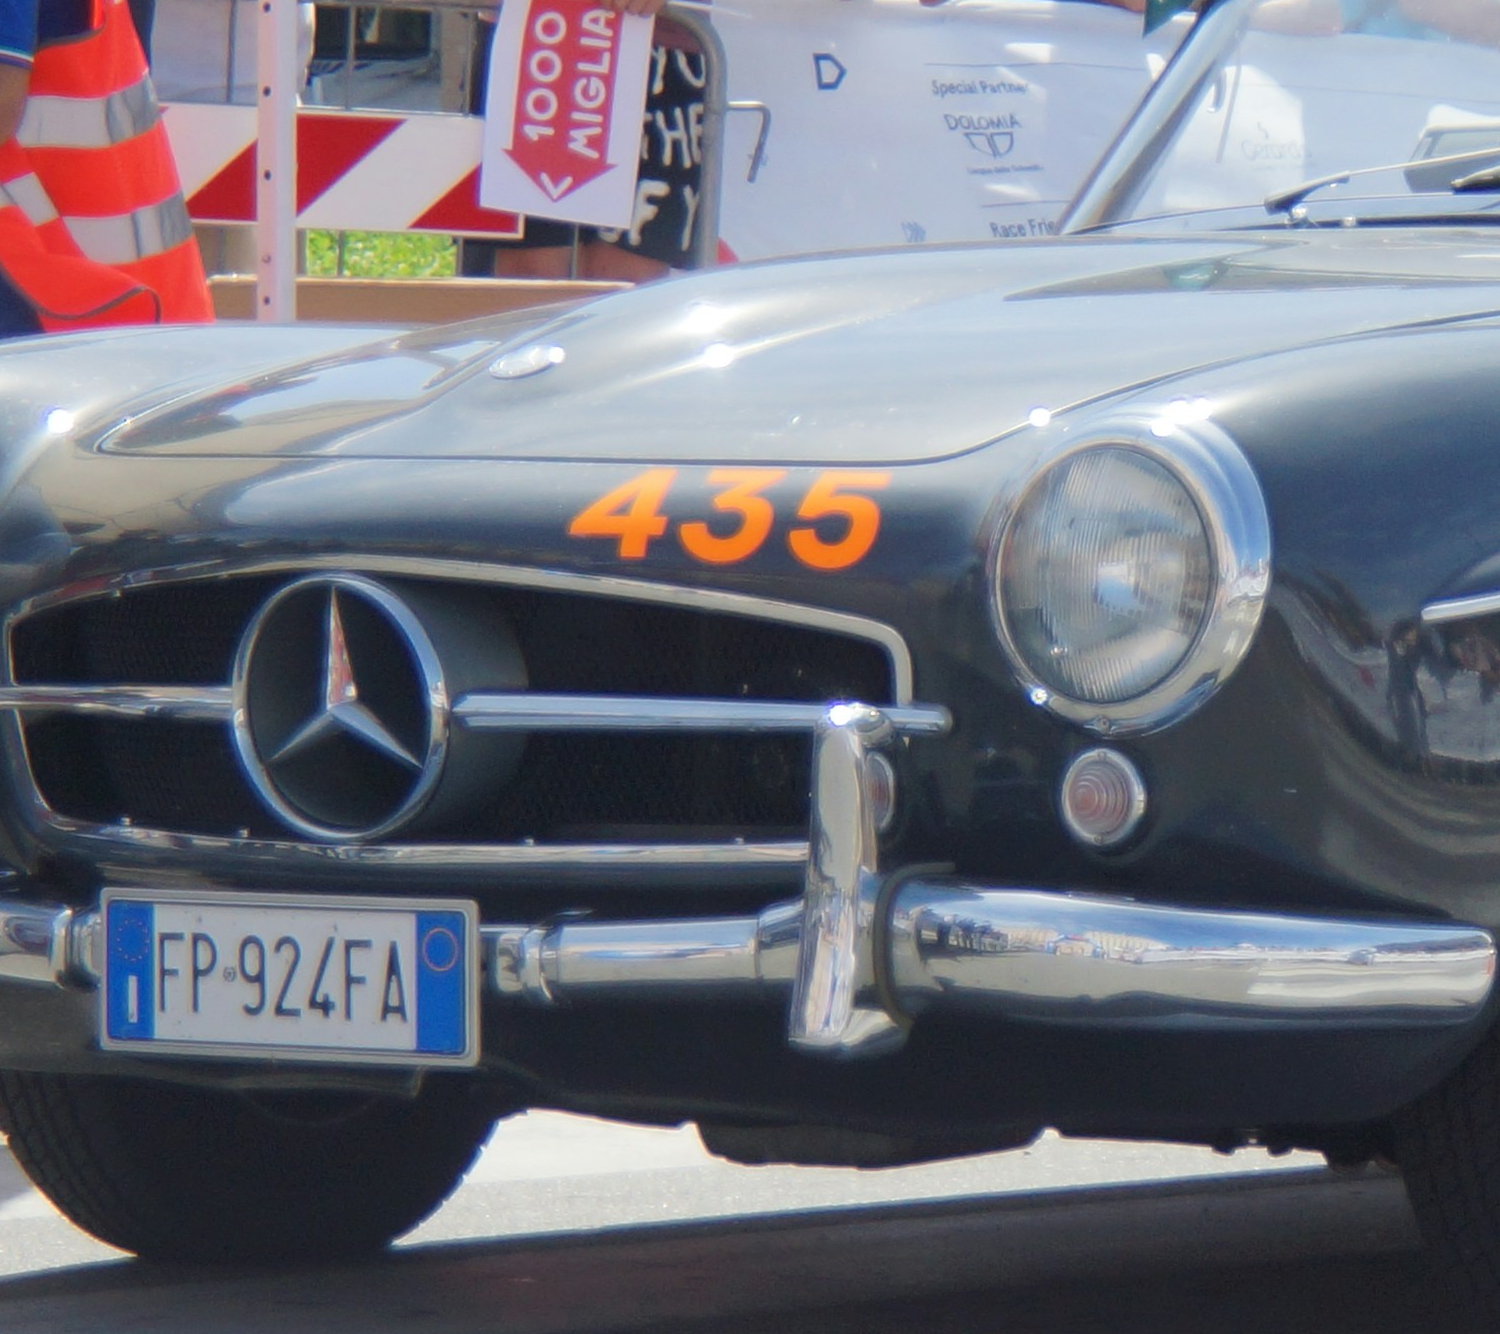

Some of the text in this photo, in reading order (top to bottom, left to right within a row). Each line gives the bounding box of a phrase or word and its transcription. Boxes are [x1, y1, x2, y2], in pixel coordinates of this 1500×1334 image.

[521, 10, 568, 142] 1000
[567, 7, 616, 160] MIGLIA
[943, 113, 1022, 131] DOLOMIA
[989, 220, 1026, 239] Race
[567, 467, 894, 571] 435
